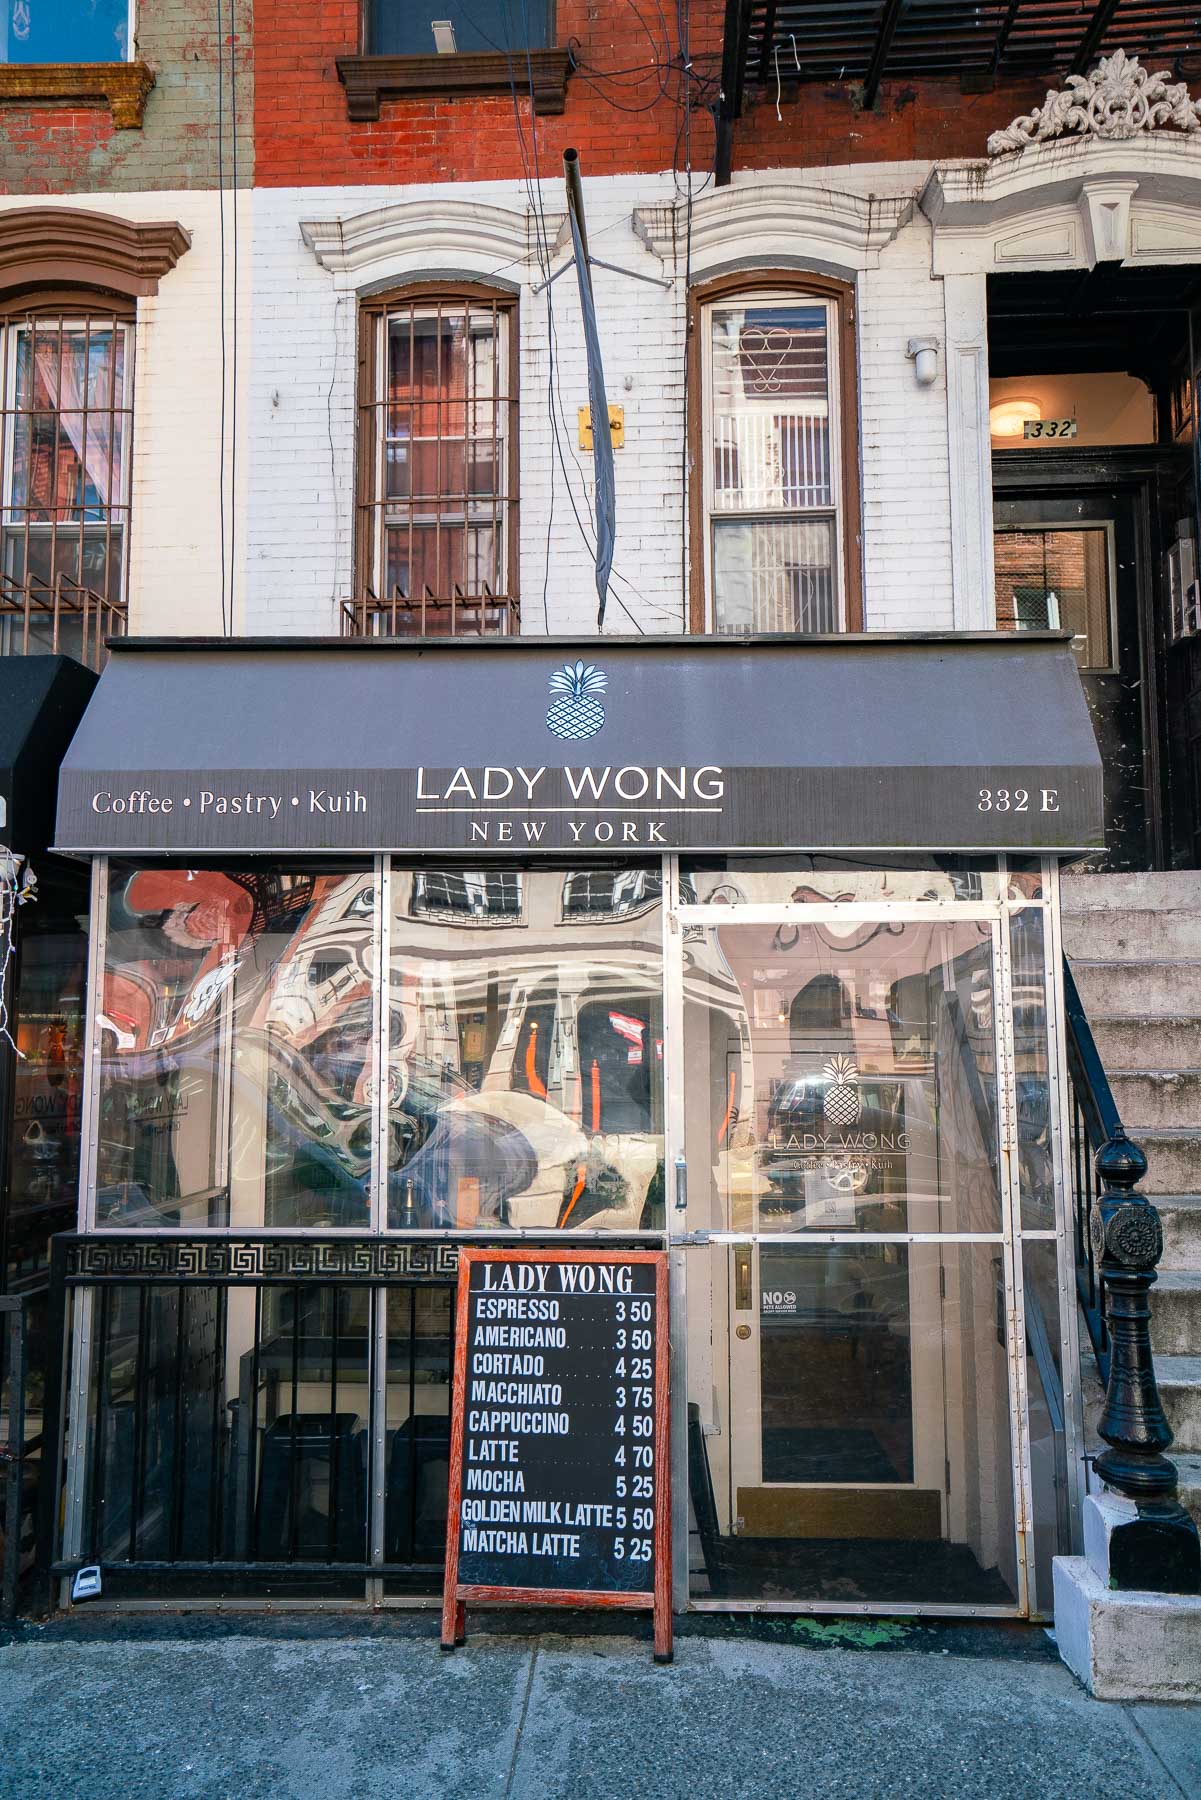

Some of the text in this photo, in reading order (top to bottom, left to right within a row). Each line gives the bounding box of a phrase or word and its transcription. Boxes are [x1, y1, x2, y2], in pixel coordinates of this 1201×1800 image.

[1030, 420, 1071, 438] 332
[416, 766, 724, 800] LADY WONG
[92, 790, 367, 819] Coffee Pastry Kuih
[978, 790, 1060, 812] 332 E
[470, 822, 667, 842] NEW YORK
[773, 1132, 912, 1150] LADY WONG
[483, 1264, 633, 1293] LADY WONG
[476, 1298, 651, 1322] ESPRESSO 3 50
[762, 1292, 782, 1304] NO
[474, 1326, 651, 1350] AMERICANO 3 50
[473, 1353, 652, 1379] CORTADO 4 25
[472, 1380, 652, 1408] MACCHIATO 3 75
[469, 1410, 652, 1437] CAPPUCCINO 4 50
[468, 1439, 653, 1468] LATTE 4 70
[467, 1469, 653, 1498] MOCHA 5 25
[462, 1499, 654, 1530] GOLDEN MILK LATTE 5 50
[463, 1530, 652, 1561] MATCHA LATTE 5 25
